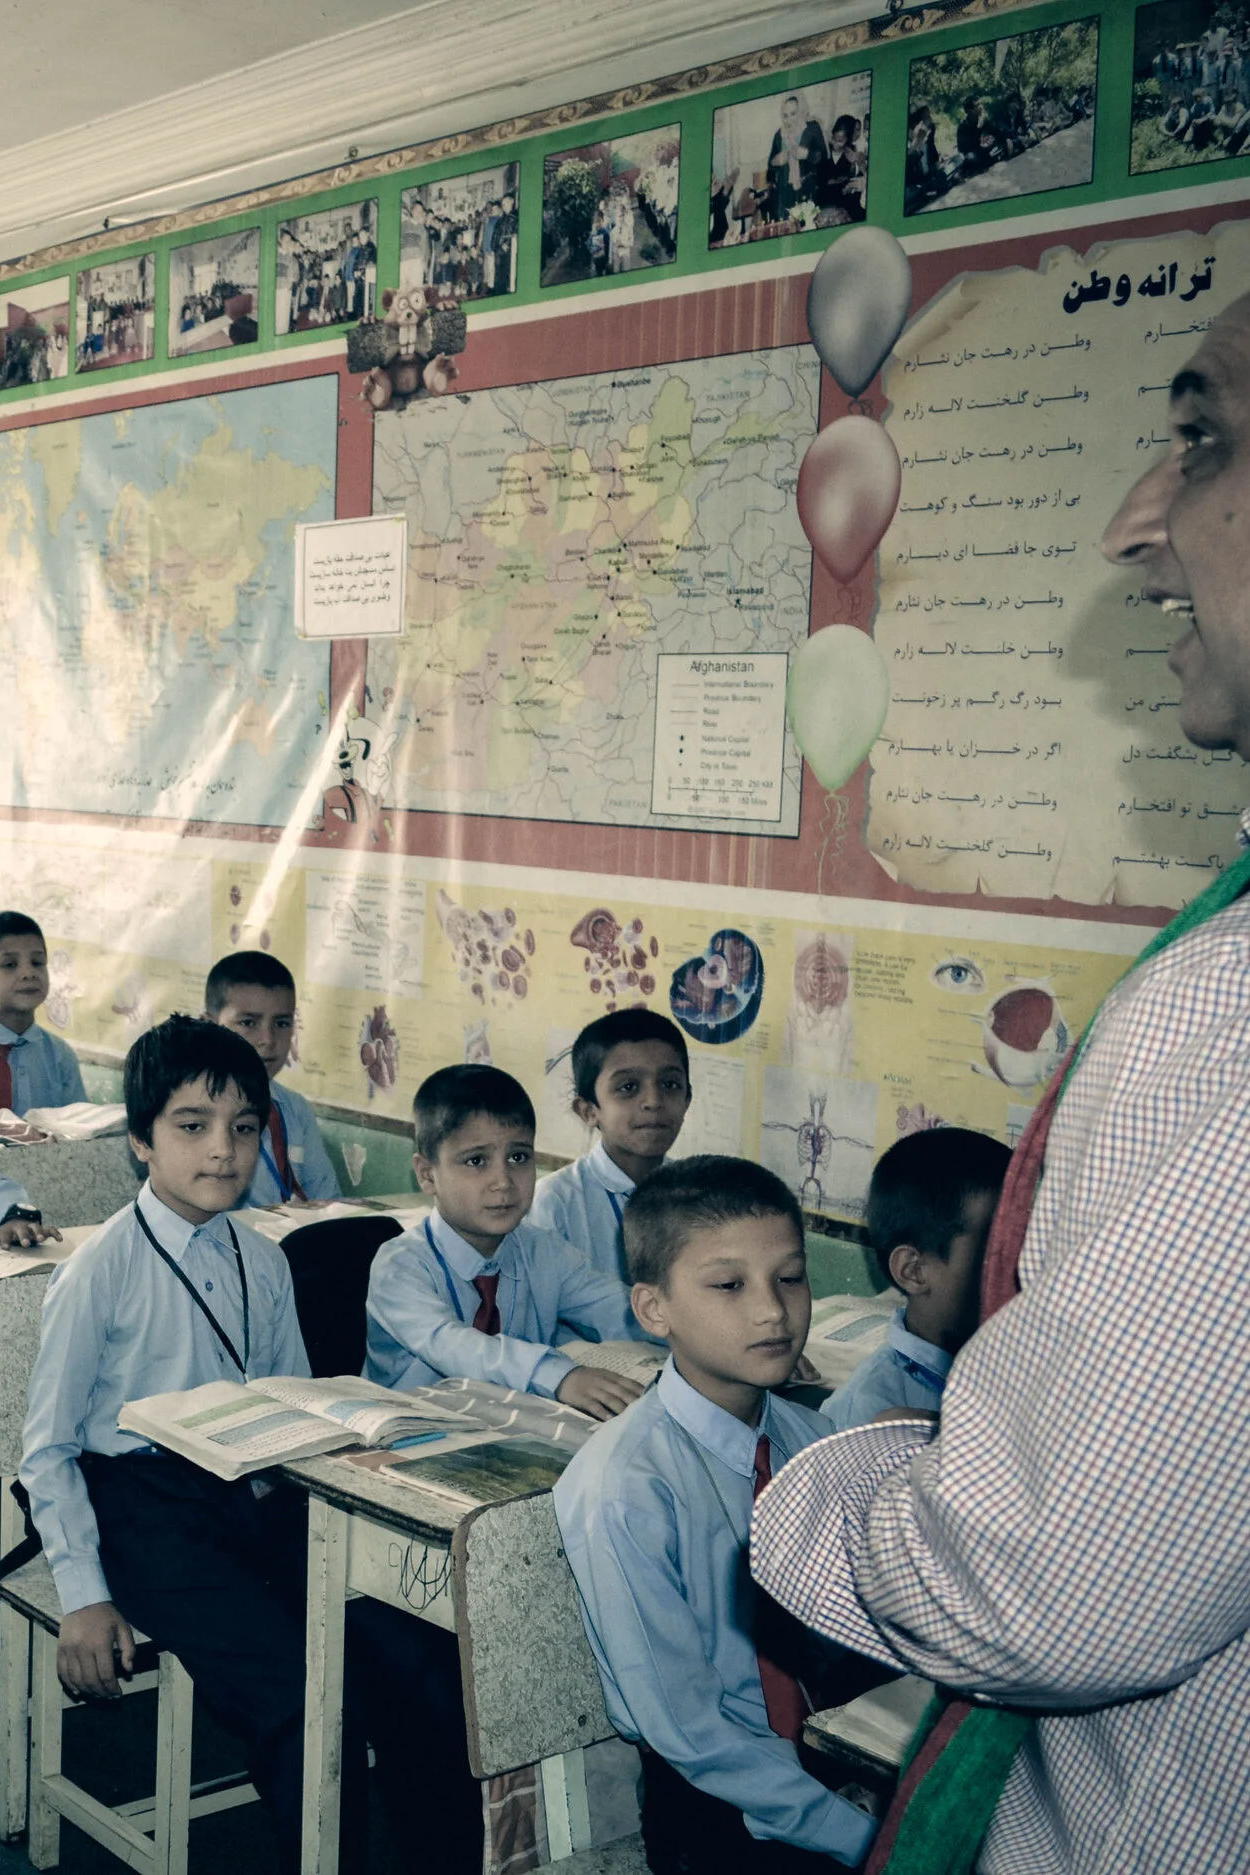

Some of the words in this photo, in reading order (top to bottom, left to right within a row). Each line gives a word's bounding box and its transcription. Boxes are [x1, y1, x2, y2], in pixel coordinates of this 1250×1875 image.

[1137, 256, 1217, 302] ترانه
[1063, 269, 1132, 314] وطن
[1022, 343, 1036, 359] در
[1040, 333, 1091, 356] وطن
[953, 349, 976, 367] جان
[1032, 384, 1089, 408] وطن
[903, 401, 924, 421] زارم
[951, 446, 974, 465] جان
[1020, 445, 1034, 459] در
[1037, 436, 1083, 458] وطن
[961, 494, 1002, 507] سنگ
[1006, 496, 1024, 510] بود
[1028, 494, 1048, 509] دور
[1051, 488, 1062, 508] از
[951, 502, 957, 514] و
[953, 543, 968, 561] ای
[923, 594, 946, 612] جان
[996, 595, 1010, 610] در
[1014, 590, 1064, 610] وطن
[893, 641, 914, 660] زارم
[1020, 641, 1063, 660] وطن
[690, 660, 755, 675] Afghanistan
[1009, 691, 1029, 710] رگ
[1034, 694, 1062, 710] بود
[888, 739, 942, 757] بهارم
[959, 739, 1021, 758] خزان
[1025, 747, 1039, 760] در
[1043, 741, 1062, 761] اگر
[1122, 744, 1141, 763] دل
[911, 787, 933, 805] جان
[990, 794, 1003, 808] در
[1007, 793, 1058, 811] وطن
[1117, 796, 1176, 817] افتخارم
[1180, 802, 1193, 818] تو
[997, 842, 1052, 862] وطن
